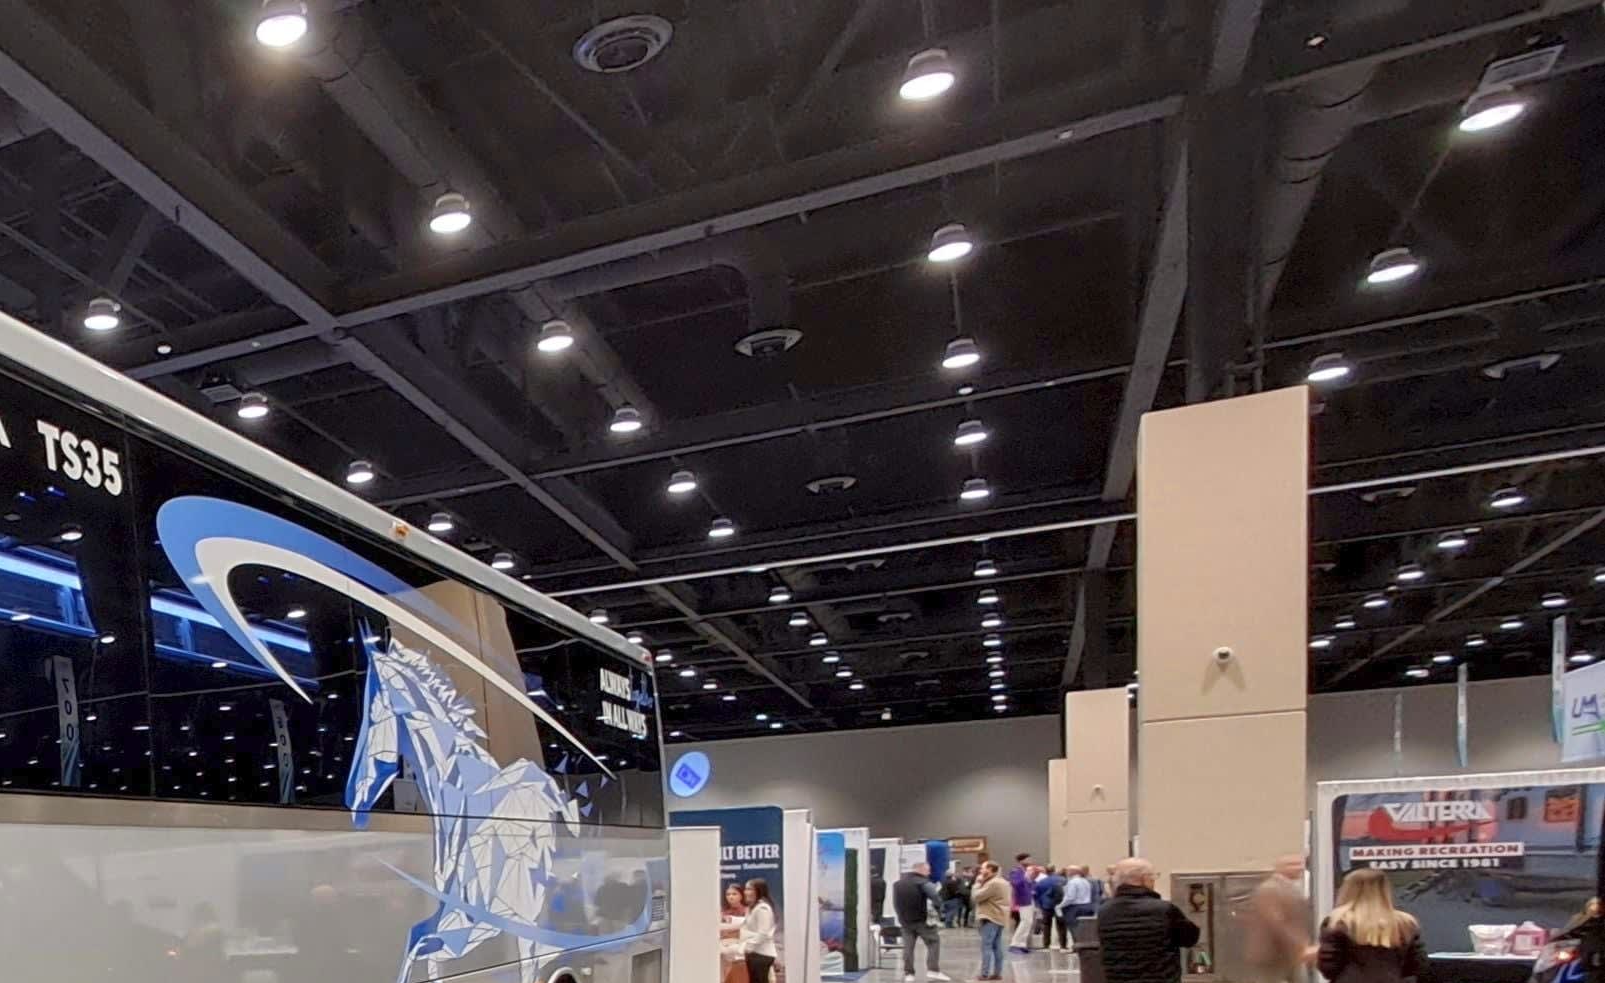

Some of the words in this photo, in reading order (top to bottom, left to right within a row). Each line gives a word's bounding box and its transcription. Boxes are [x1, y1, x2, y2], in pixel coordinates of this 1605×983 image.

[37, 419, 123, 497] TS35
[1383, 800, 1494, 822] VALTERRA
[736, 843, 781, 860] BETTER
[1352, 846, 1414, 858] MAKING
[1419, 844, 1520, 857] RECREATION
[1369, 859, 1408, 870] EASY
[1411, 858, 1459, 869] SINCE
[1462, 858, 1500, 868] 1981
